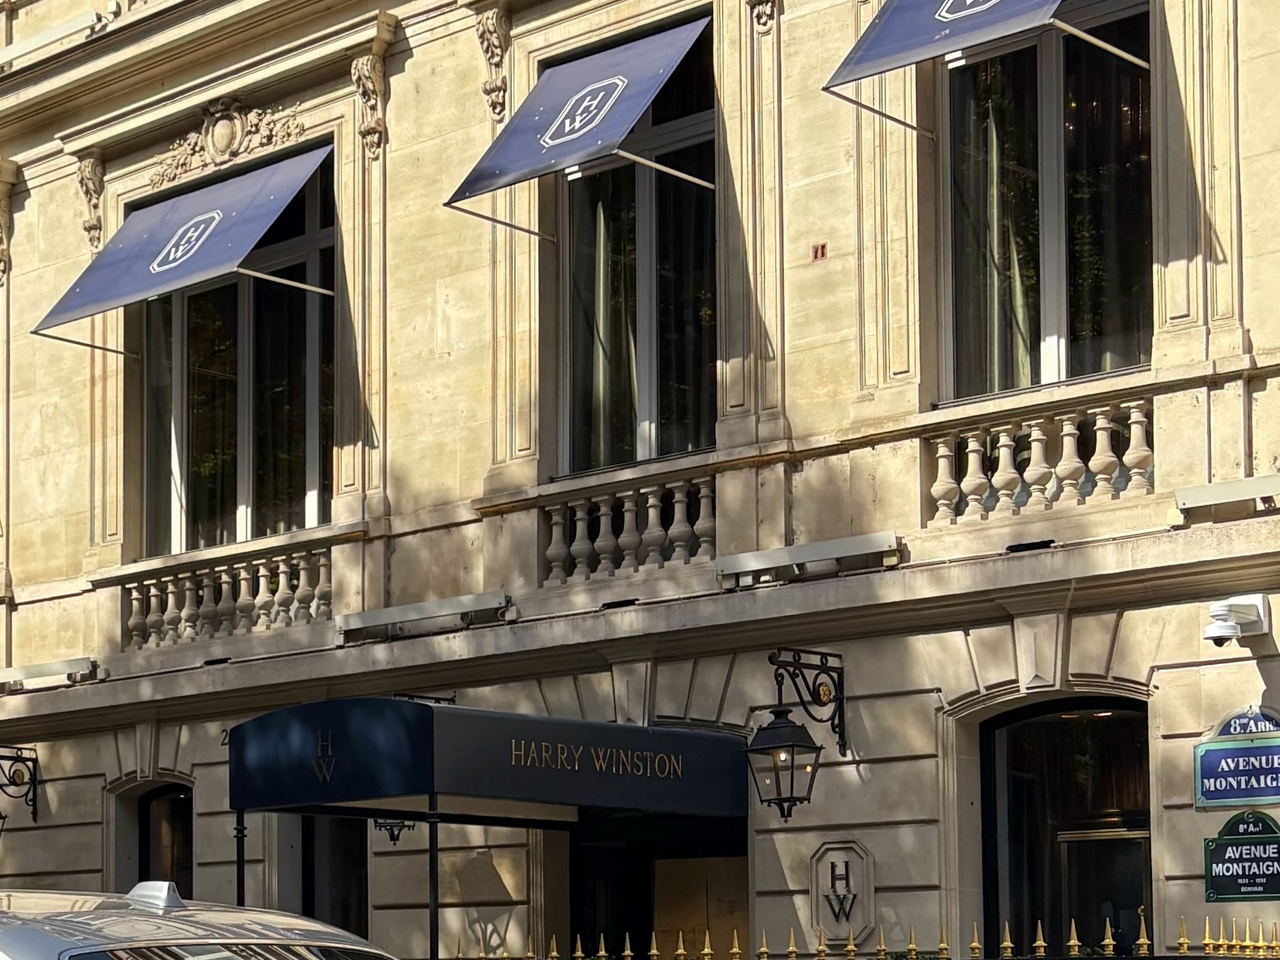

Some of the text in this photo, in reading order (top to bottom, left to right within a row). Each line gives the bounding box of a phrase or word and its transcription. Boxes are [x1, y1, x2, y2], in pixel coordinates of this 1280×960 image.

[511, 739, 683, 779] HARRY WINSTON
[1218, 755, 1280, 772] AVENUE
[1225, 844, 1279, 860] AVENUE
[829, 860, 850, 890] H
[822, 893, 858, 923] W
